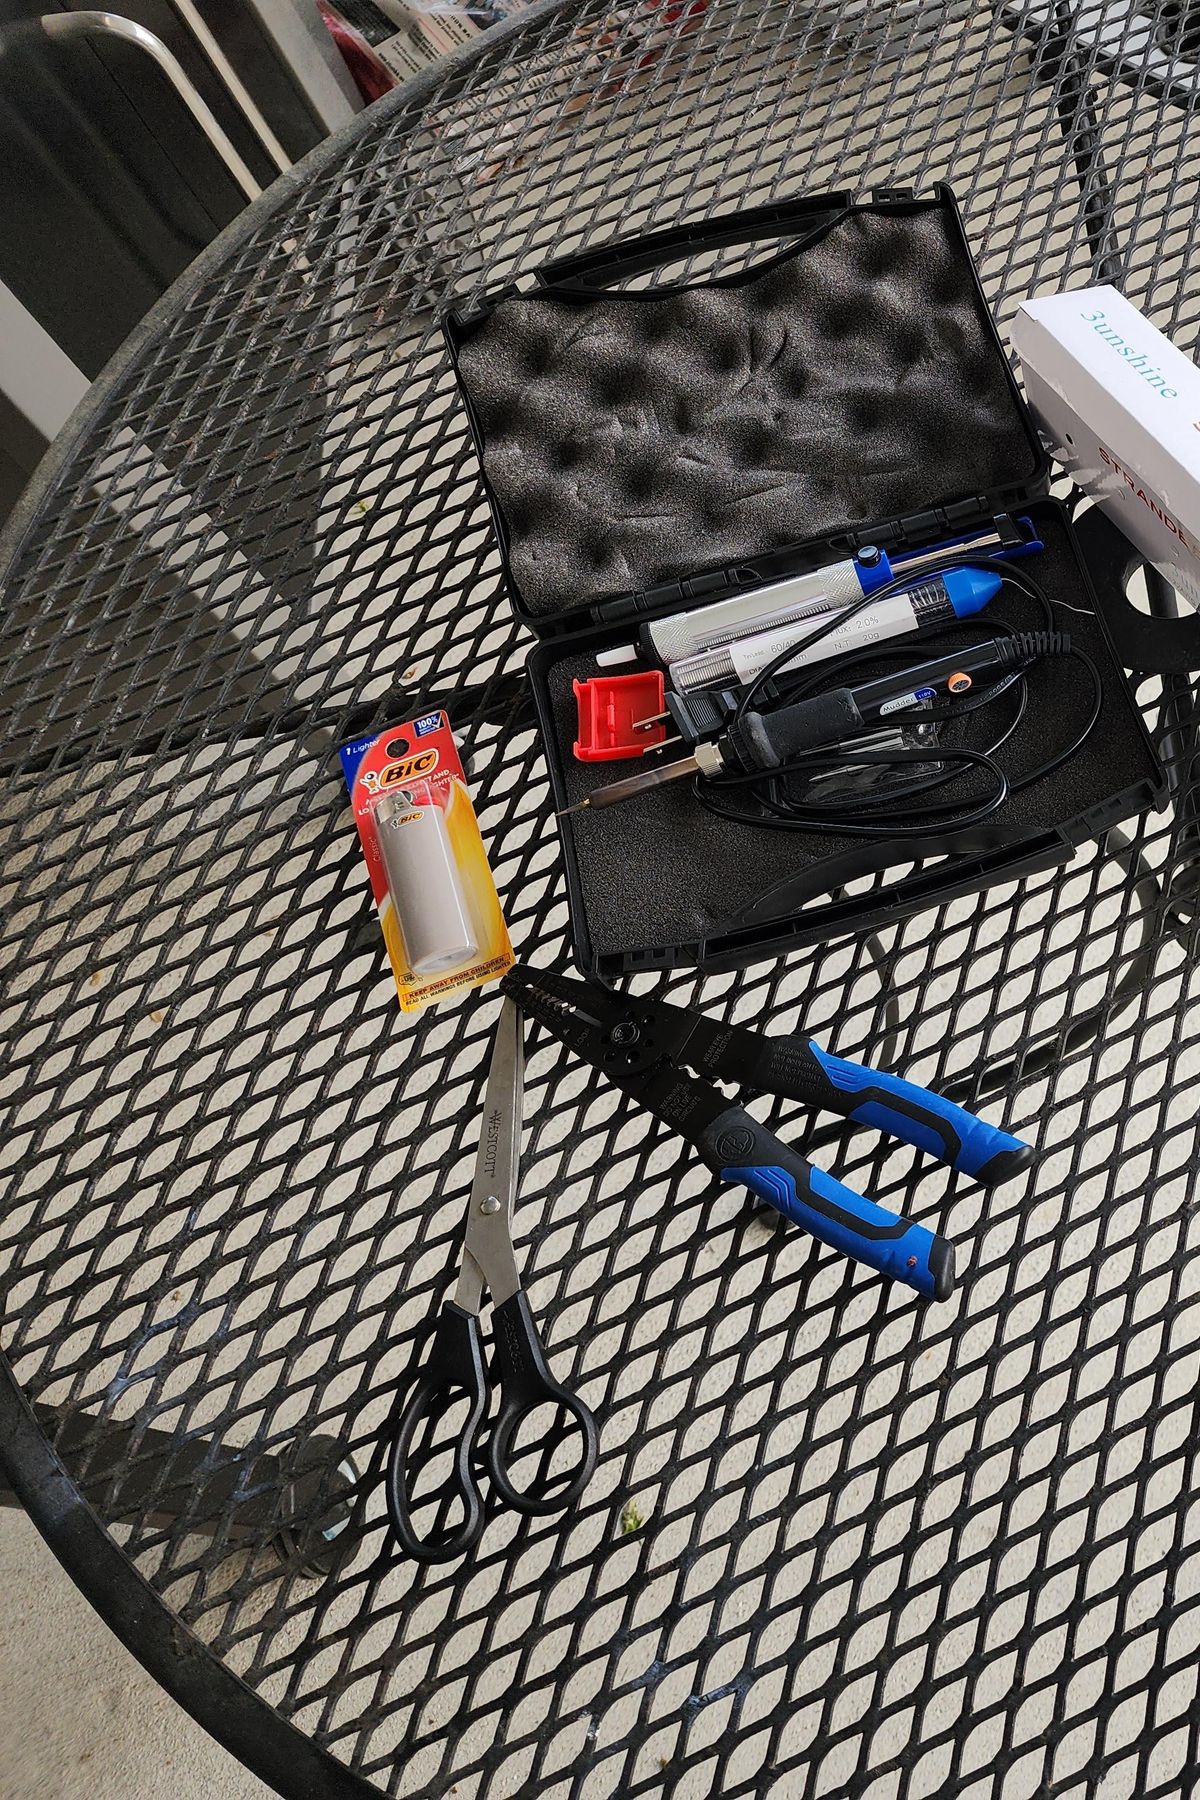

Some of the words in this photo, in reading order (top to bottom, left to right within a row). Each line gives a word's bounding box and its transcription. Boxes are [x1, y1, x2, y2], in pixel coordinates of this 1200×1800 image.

[863, 632, 880, 642] 20g
[883, 696, 915, 713] Mudder
[417, 715, 438, 729] 100%
[345, 747, 351, 756] 1
[352, 739, 380, 754] Lighter
[409, 987, 428, 998] KEEP
[430, 980, 448, 991] AWAY
[450, 972, 470, 983] FROM
[470, 957, 505, 974] CHILDREN
[430, 984, 456, 997] WARNINGS
[457, 976, 475, 987] BEFORE
[476, 970, 491, 979] USING
[491, 961, 511, 974] LIGHTER
[484, 1110, 502, 1174] WESTCOTT
